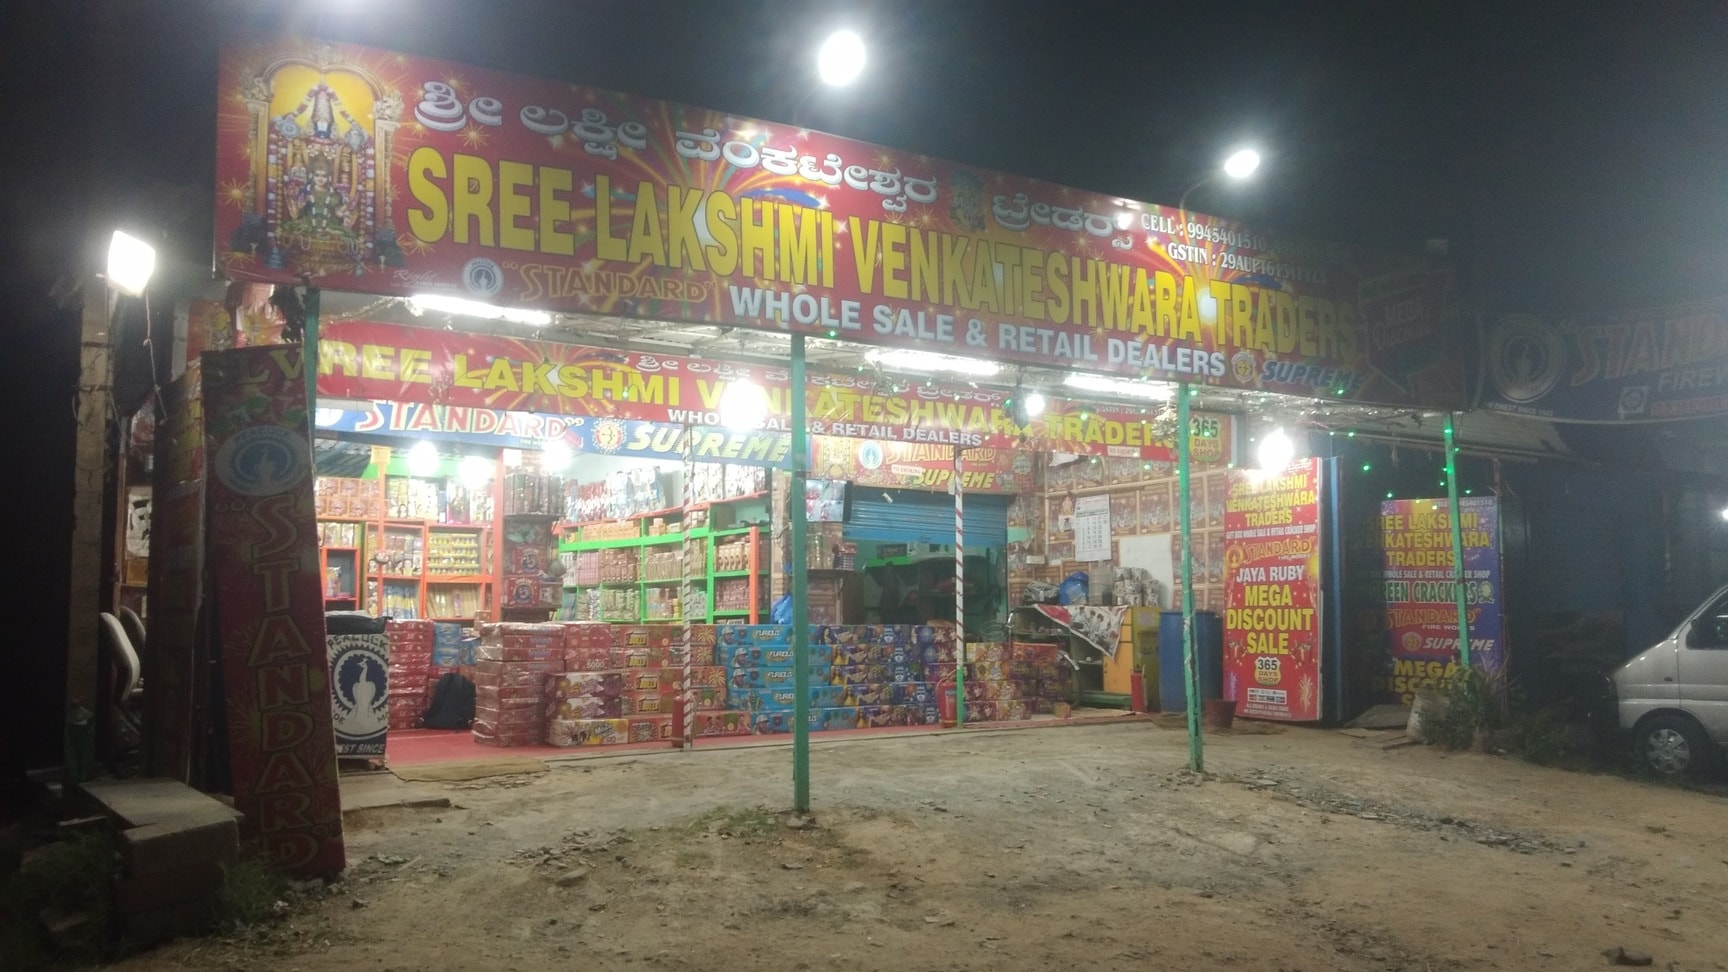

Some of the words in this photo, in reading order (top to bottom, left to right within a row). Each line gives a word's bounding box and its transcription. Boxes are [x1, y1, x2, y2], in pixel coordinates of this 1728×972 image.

[414, 81, 503, 132] ಶ್ರೀ
[1141, 213, 1176, 235] CELL
[407, 146, 575, 255] SREE
[596, 175, 834, 288] LAKSHMI
[848, 216, 1202, 343] VENKATESHWARA
[1209, 279, 1358, 364] TRADERS
[1167, 242, 1208, 265] GSTIN
[729, 285, 862, 330] WHOLE
[873, 304, 955, 343] SALE
[965, 318, 988, 347] &
[998, 322, 1099, 362] RETAIL
[1108, 338, 1226, 378] DEALERS
[454, 354, 680, 406] LAKSHMI
[1260, 360, 1363, 391] SUPREME
[832, 422, 898, 440] RETAIL
[903, 427, 982, 446] DEALERS
[1193, 417, 1219, 438] 365
[627, 424, 794, 462] SUPREME
[1193, 438, 1219, 448] DAYS
[1193, 448, 1219, 458] SHOP
[1245, 509, 1293, 527] TRADERS
[1408, 512, 1478, 530] LAKSMI
[1386, 550, 1456, 567] TRADERS
[1236, 567, 1266, 584] JAYA
[1270, 565, 1304, 582] RUBY
[1244, 584, 1293, 607] MEGA
[1226, 608, 1314, 631] DISCOUNT
[1246, 632, 1289, 655] SALE
[1257, 659, 1278, 670] 365
[357, 743, 386, 754] SINCE
